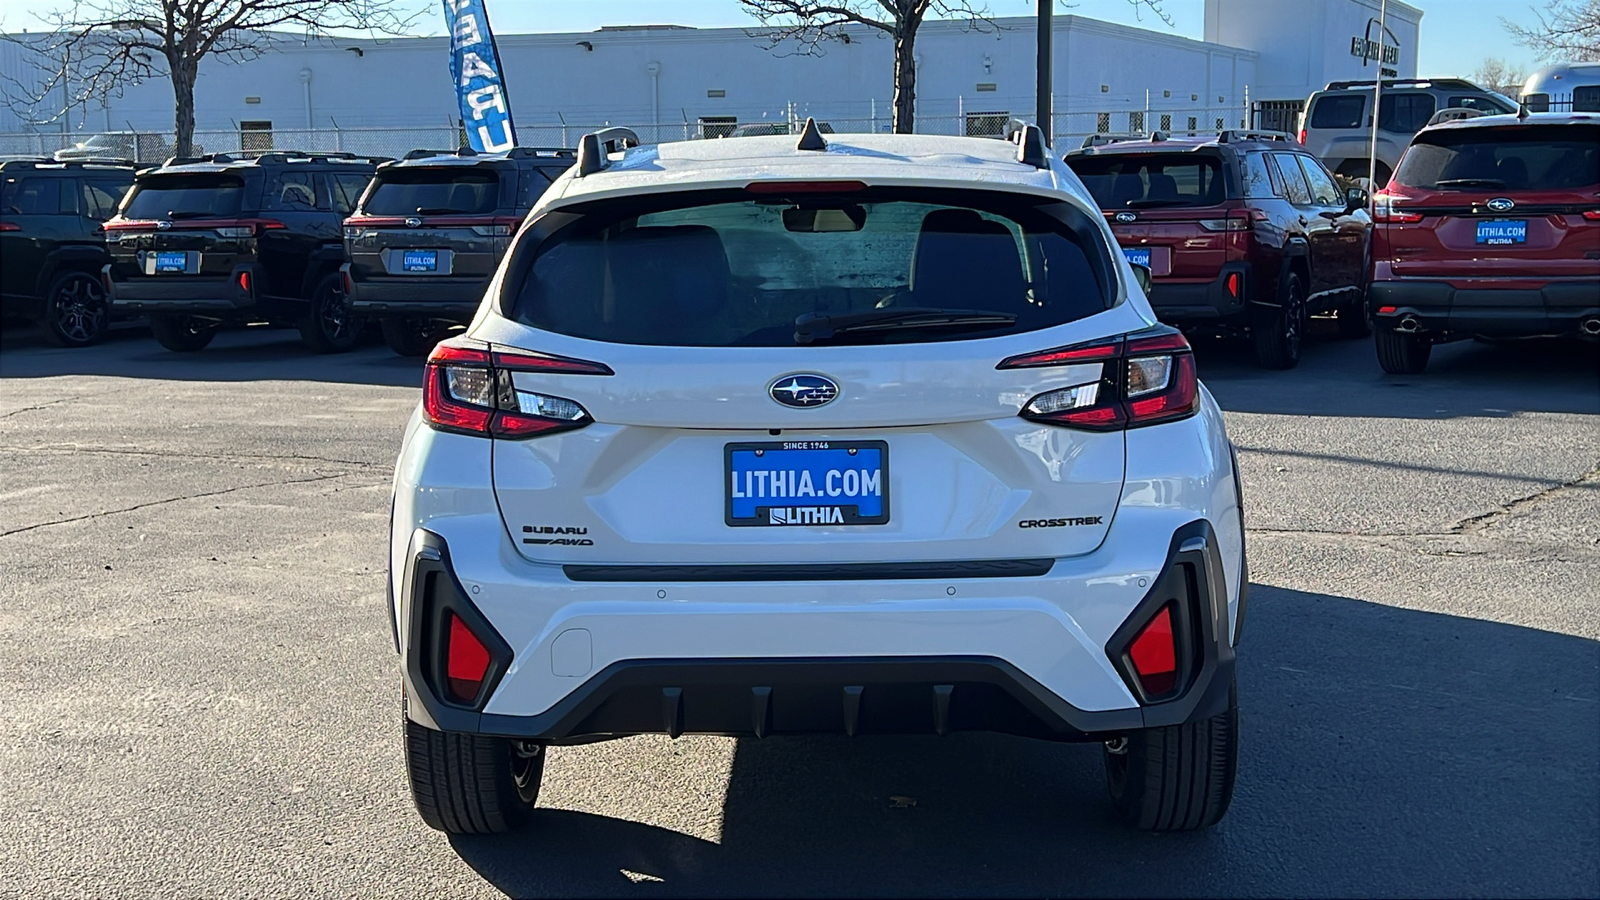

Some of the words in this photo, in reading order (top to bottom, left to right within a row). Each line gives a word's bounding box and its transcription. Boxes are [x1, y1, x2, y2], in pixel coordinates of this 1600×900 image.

[1477, 227, 1526, 237] LITHIA.COM
[404, 256, 436, 265] LITHIA.COM
[783, 442, 808, 450] SINCE
[731, 469, 882, 498] LITHIA.COM
[786, 507, 844, 524] LITHIA
[1018, 515, 1103, 529] CROSSTREK
[522, 525, 588, 535] SUBARU
[549, 538, 594, 546] AWD
